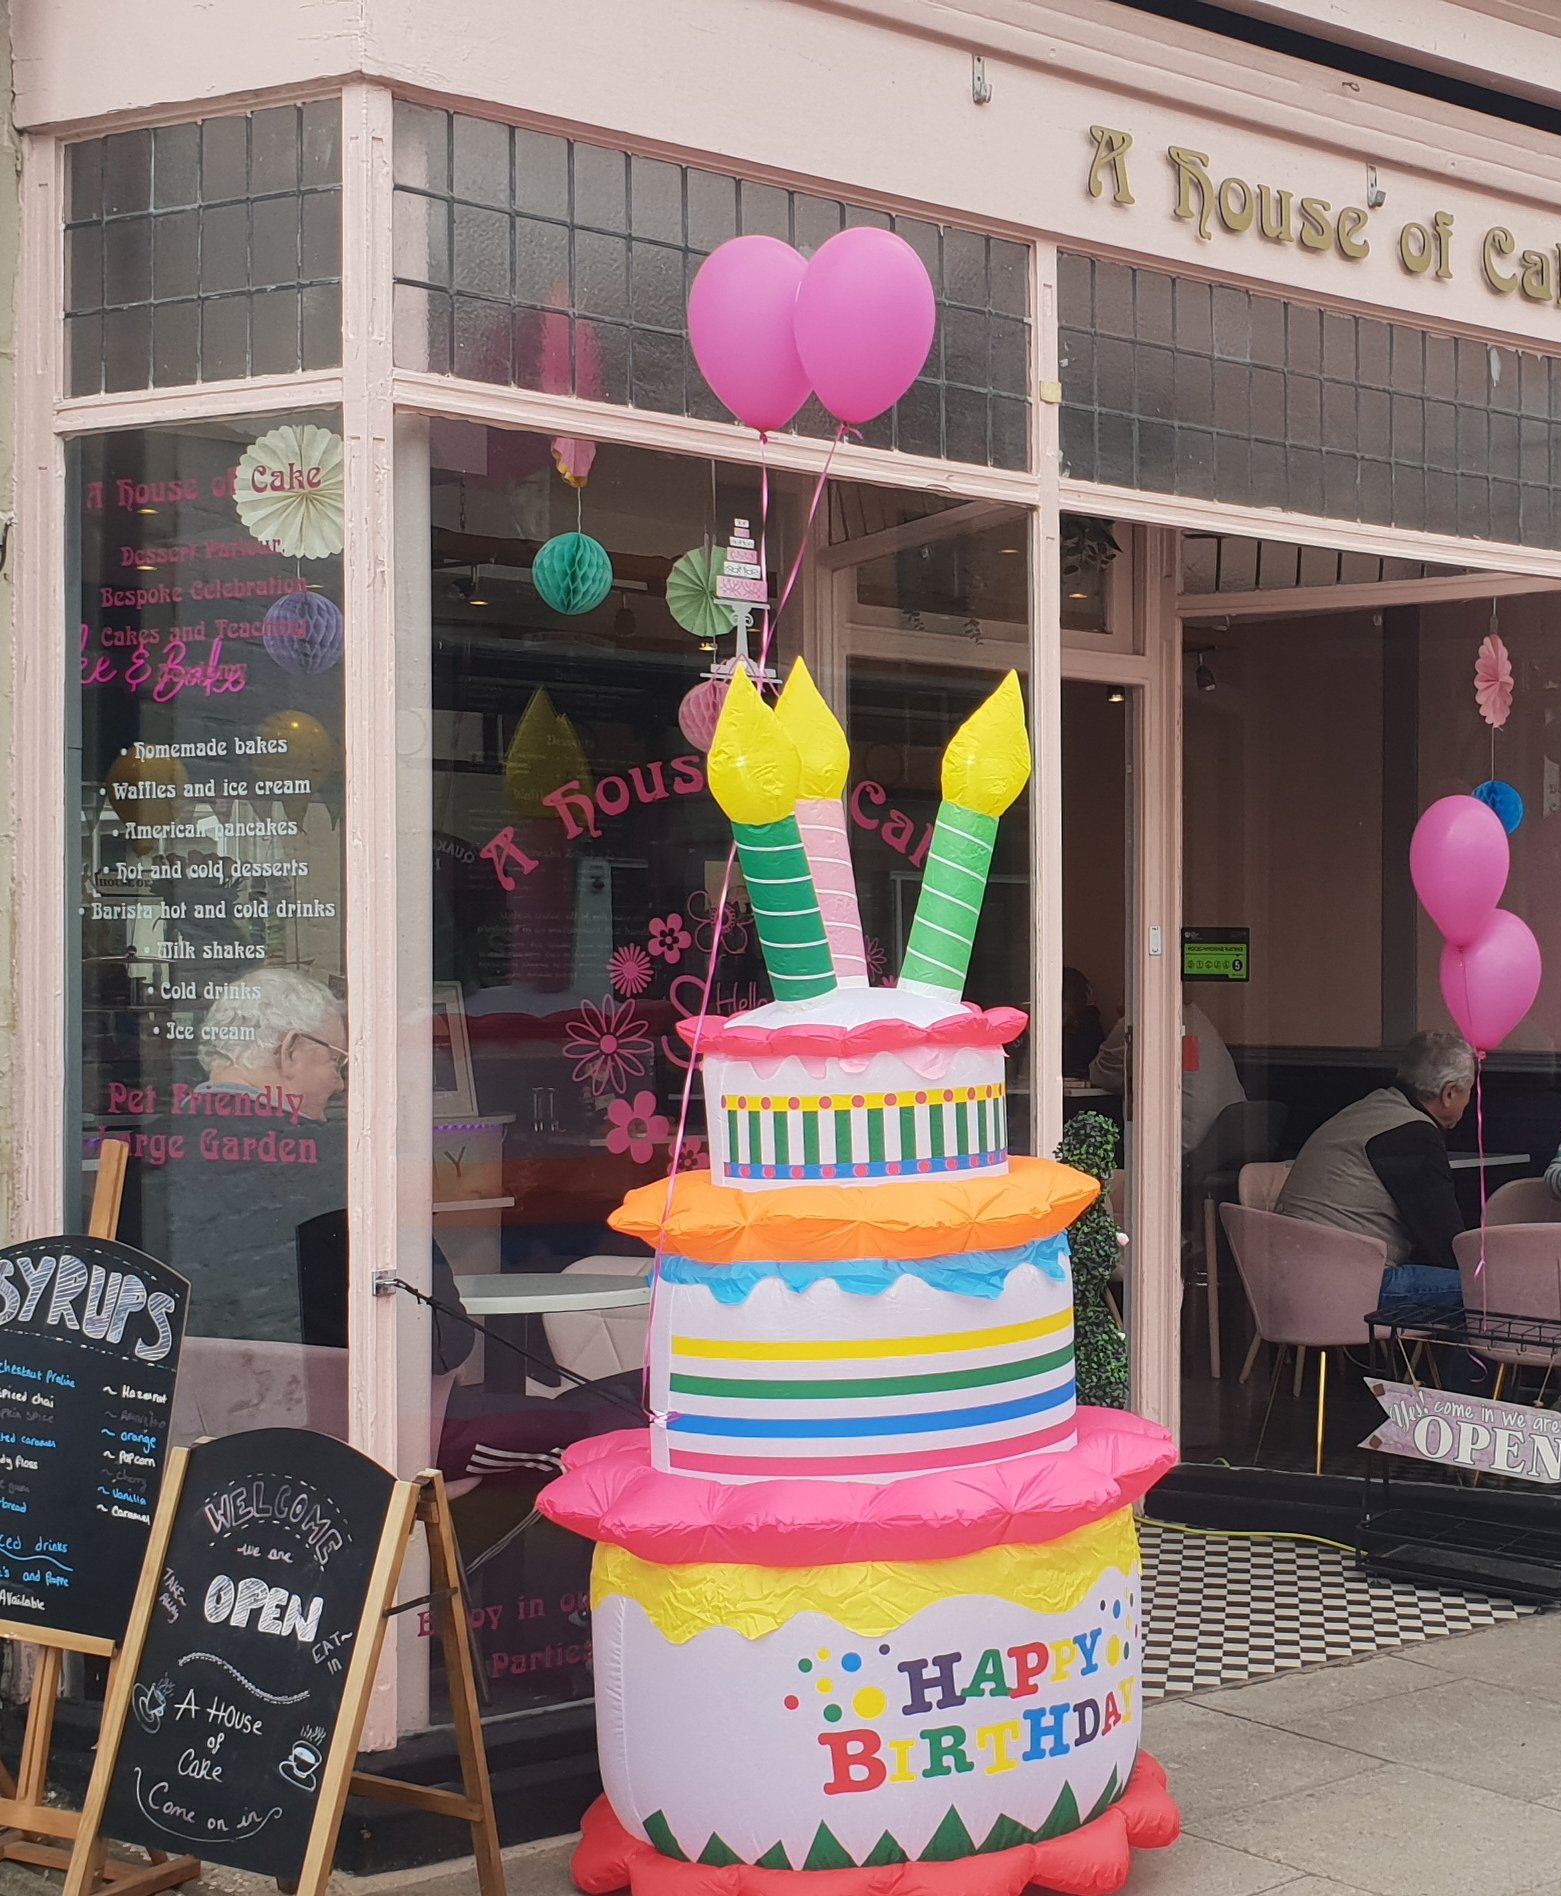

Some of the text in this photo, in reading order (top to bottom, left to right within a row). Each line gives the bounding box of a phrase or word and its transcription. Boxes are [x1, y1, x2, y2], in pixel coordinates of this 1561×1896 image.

[1088, 124, 1136, 206] A
[1166, 144, 1371, 260] House
[1400, 210, 1455, 280] of
[86, 462, 322, 512] A House of Cake
[120, 543, 198, 567] Dessert
[100, 576, 308, 609] Bespoke Celebration
[100, 618, 308, 647] Cakes and Teaching
[134, 736, 288, 762] Homemade bakes
[112, 779, 311, 800] Waffles and ice cream
[125, 818, 298, 840] American pancakes
[480, 755, 934, 892] A Hous Ca
[115, 858, 309, 882] Hot and cold desserts
[91, 899, 336, 920] Barista hot and cold drinks
[157, 940, 266, 959] Milk shakes
[1234, 960, 1241, 971] 5
[160, 981, 262, 1000] Cold drinks
[166, 1022, 256, 1041] Ice cream
[107, 1082, 305, 1126] Pet Friendly
[200, 1127, 318, 1165] Garden
[0, 1254, 176, 1361] SYRUPS
[31, 1392, 54, 1408] chai
[1388, 1390, 1429, 1433] Yes!
[1434, 1400, 1474, 1419] come
[1480, 1403, 1495, 1423] in
[1532, 1416, 1561, 1434] are
[204, 1481, 343, 1565] WELCOME
[236, 1543, 294, 1564] we are
[22, 1569, 41, 1582] and
[204, 1574, 324, 1643] OPEN
[518, 1595, 545, 1621] in
[897, 1626, 1103, 1716] HAPPY
[174, 1688, 201, 1721] A
[207, 1732, 225, 1754] of
[817, 1674, 1137, 1796] BIRTHDAY
[177, 1748, 223, 1783] Cake
[148, 1781, 263, 1831] Come on in
